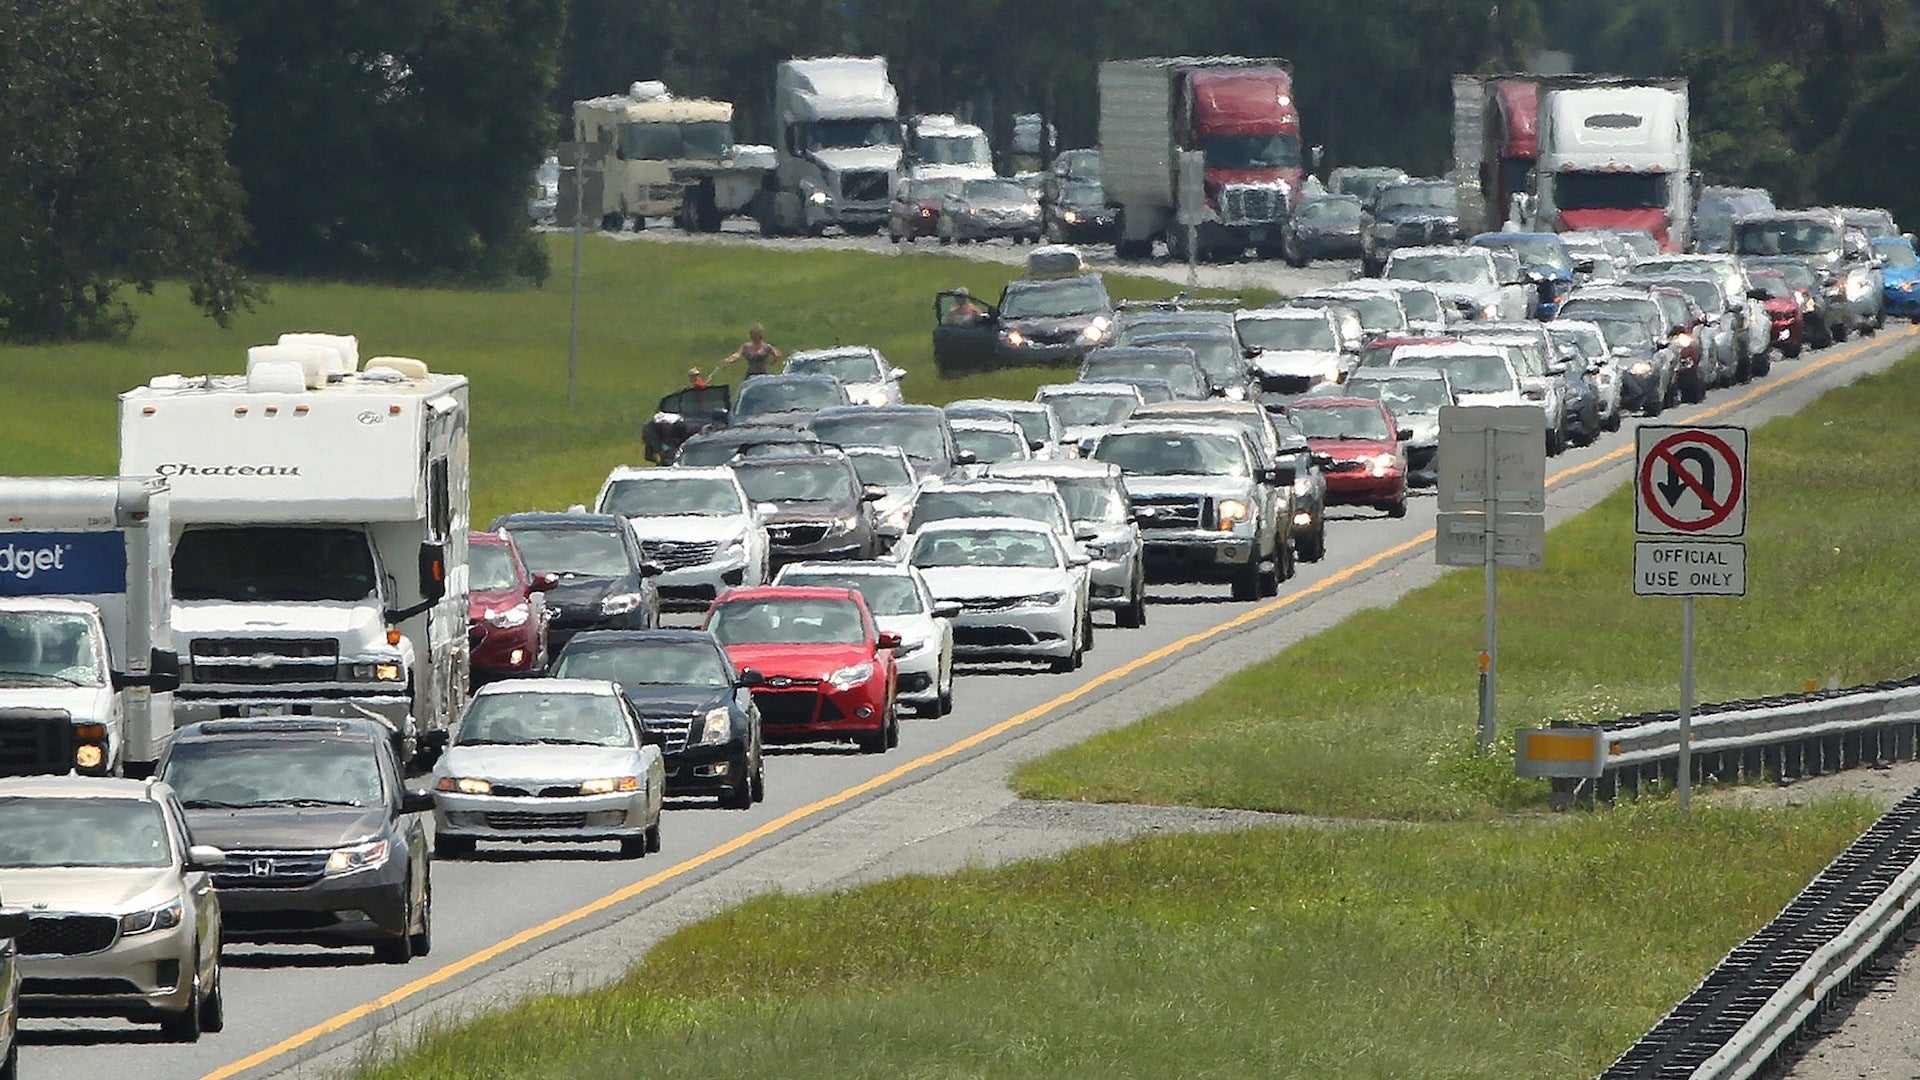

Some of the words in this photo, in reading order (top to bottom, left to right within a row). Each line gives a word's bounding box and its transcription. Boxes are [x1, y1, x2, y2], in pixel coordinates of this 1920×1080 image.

[155, 463, 301, 477] Chateau
[1653, 549, 1728, 565] OFFICIAL
[1645, 571, 1679, 587] USE
[1690, 572, 1733, 586] ONLY
